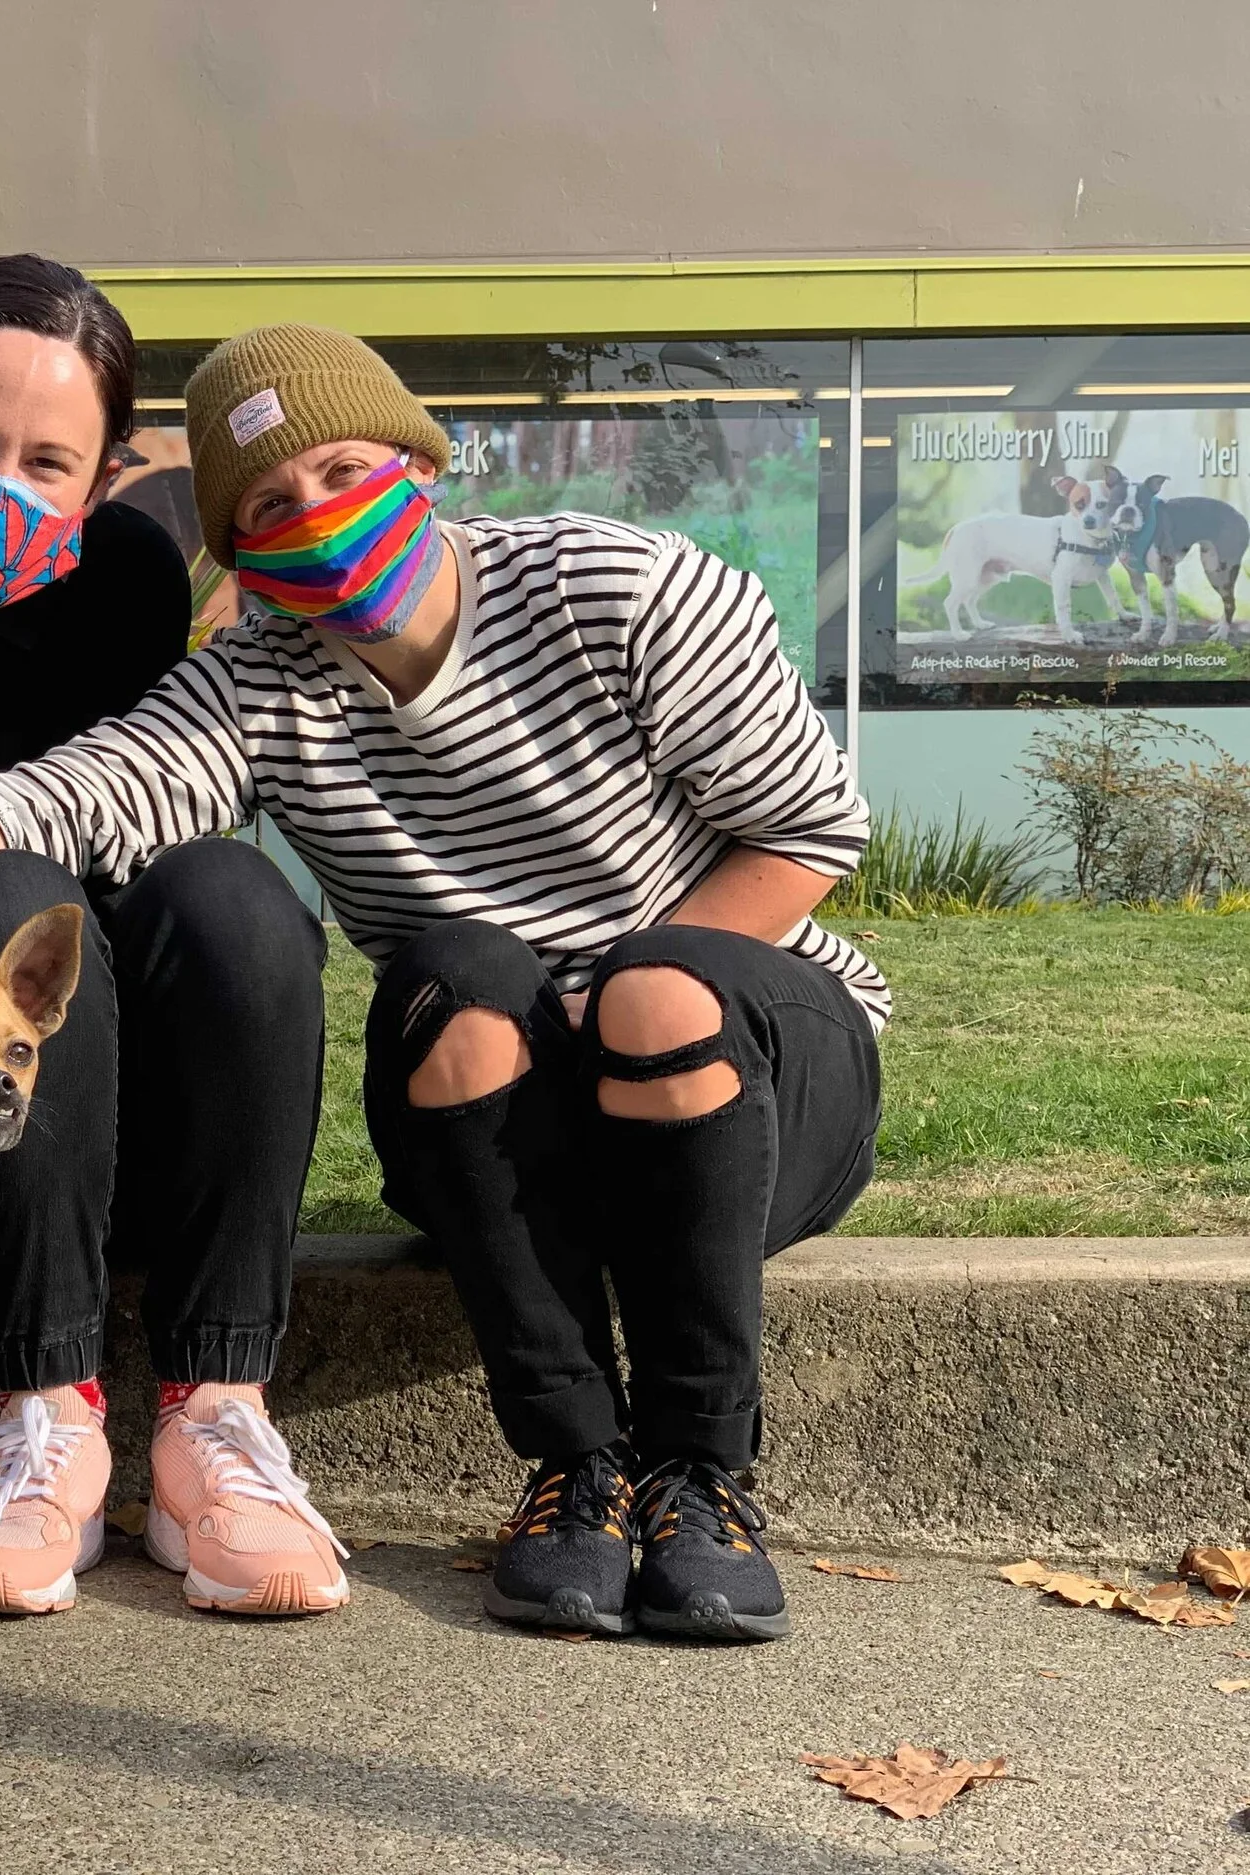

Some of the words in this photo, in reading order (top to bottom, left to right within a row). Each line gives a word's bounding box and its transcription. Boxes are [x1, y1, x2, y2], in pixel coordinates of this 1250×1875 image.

[911, 421, 1054, 467] Huckleberry
[1060, 420, 1109, 461] Slim
[1199, 437, 1239, 477] Mei
[911, 654, 963, 672] Adopted:
[965, 655, 1008, 671] Rocket
[1009, 655, 1030, 671] Dog
[1032, 654, 1079, 669] Rescue,
[1116, 652, 1160, 667] Wonder
[1162, 654, 1183, 669] Dog
[1184, 653, 1227, 667] Rescue
